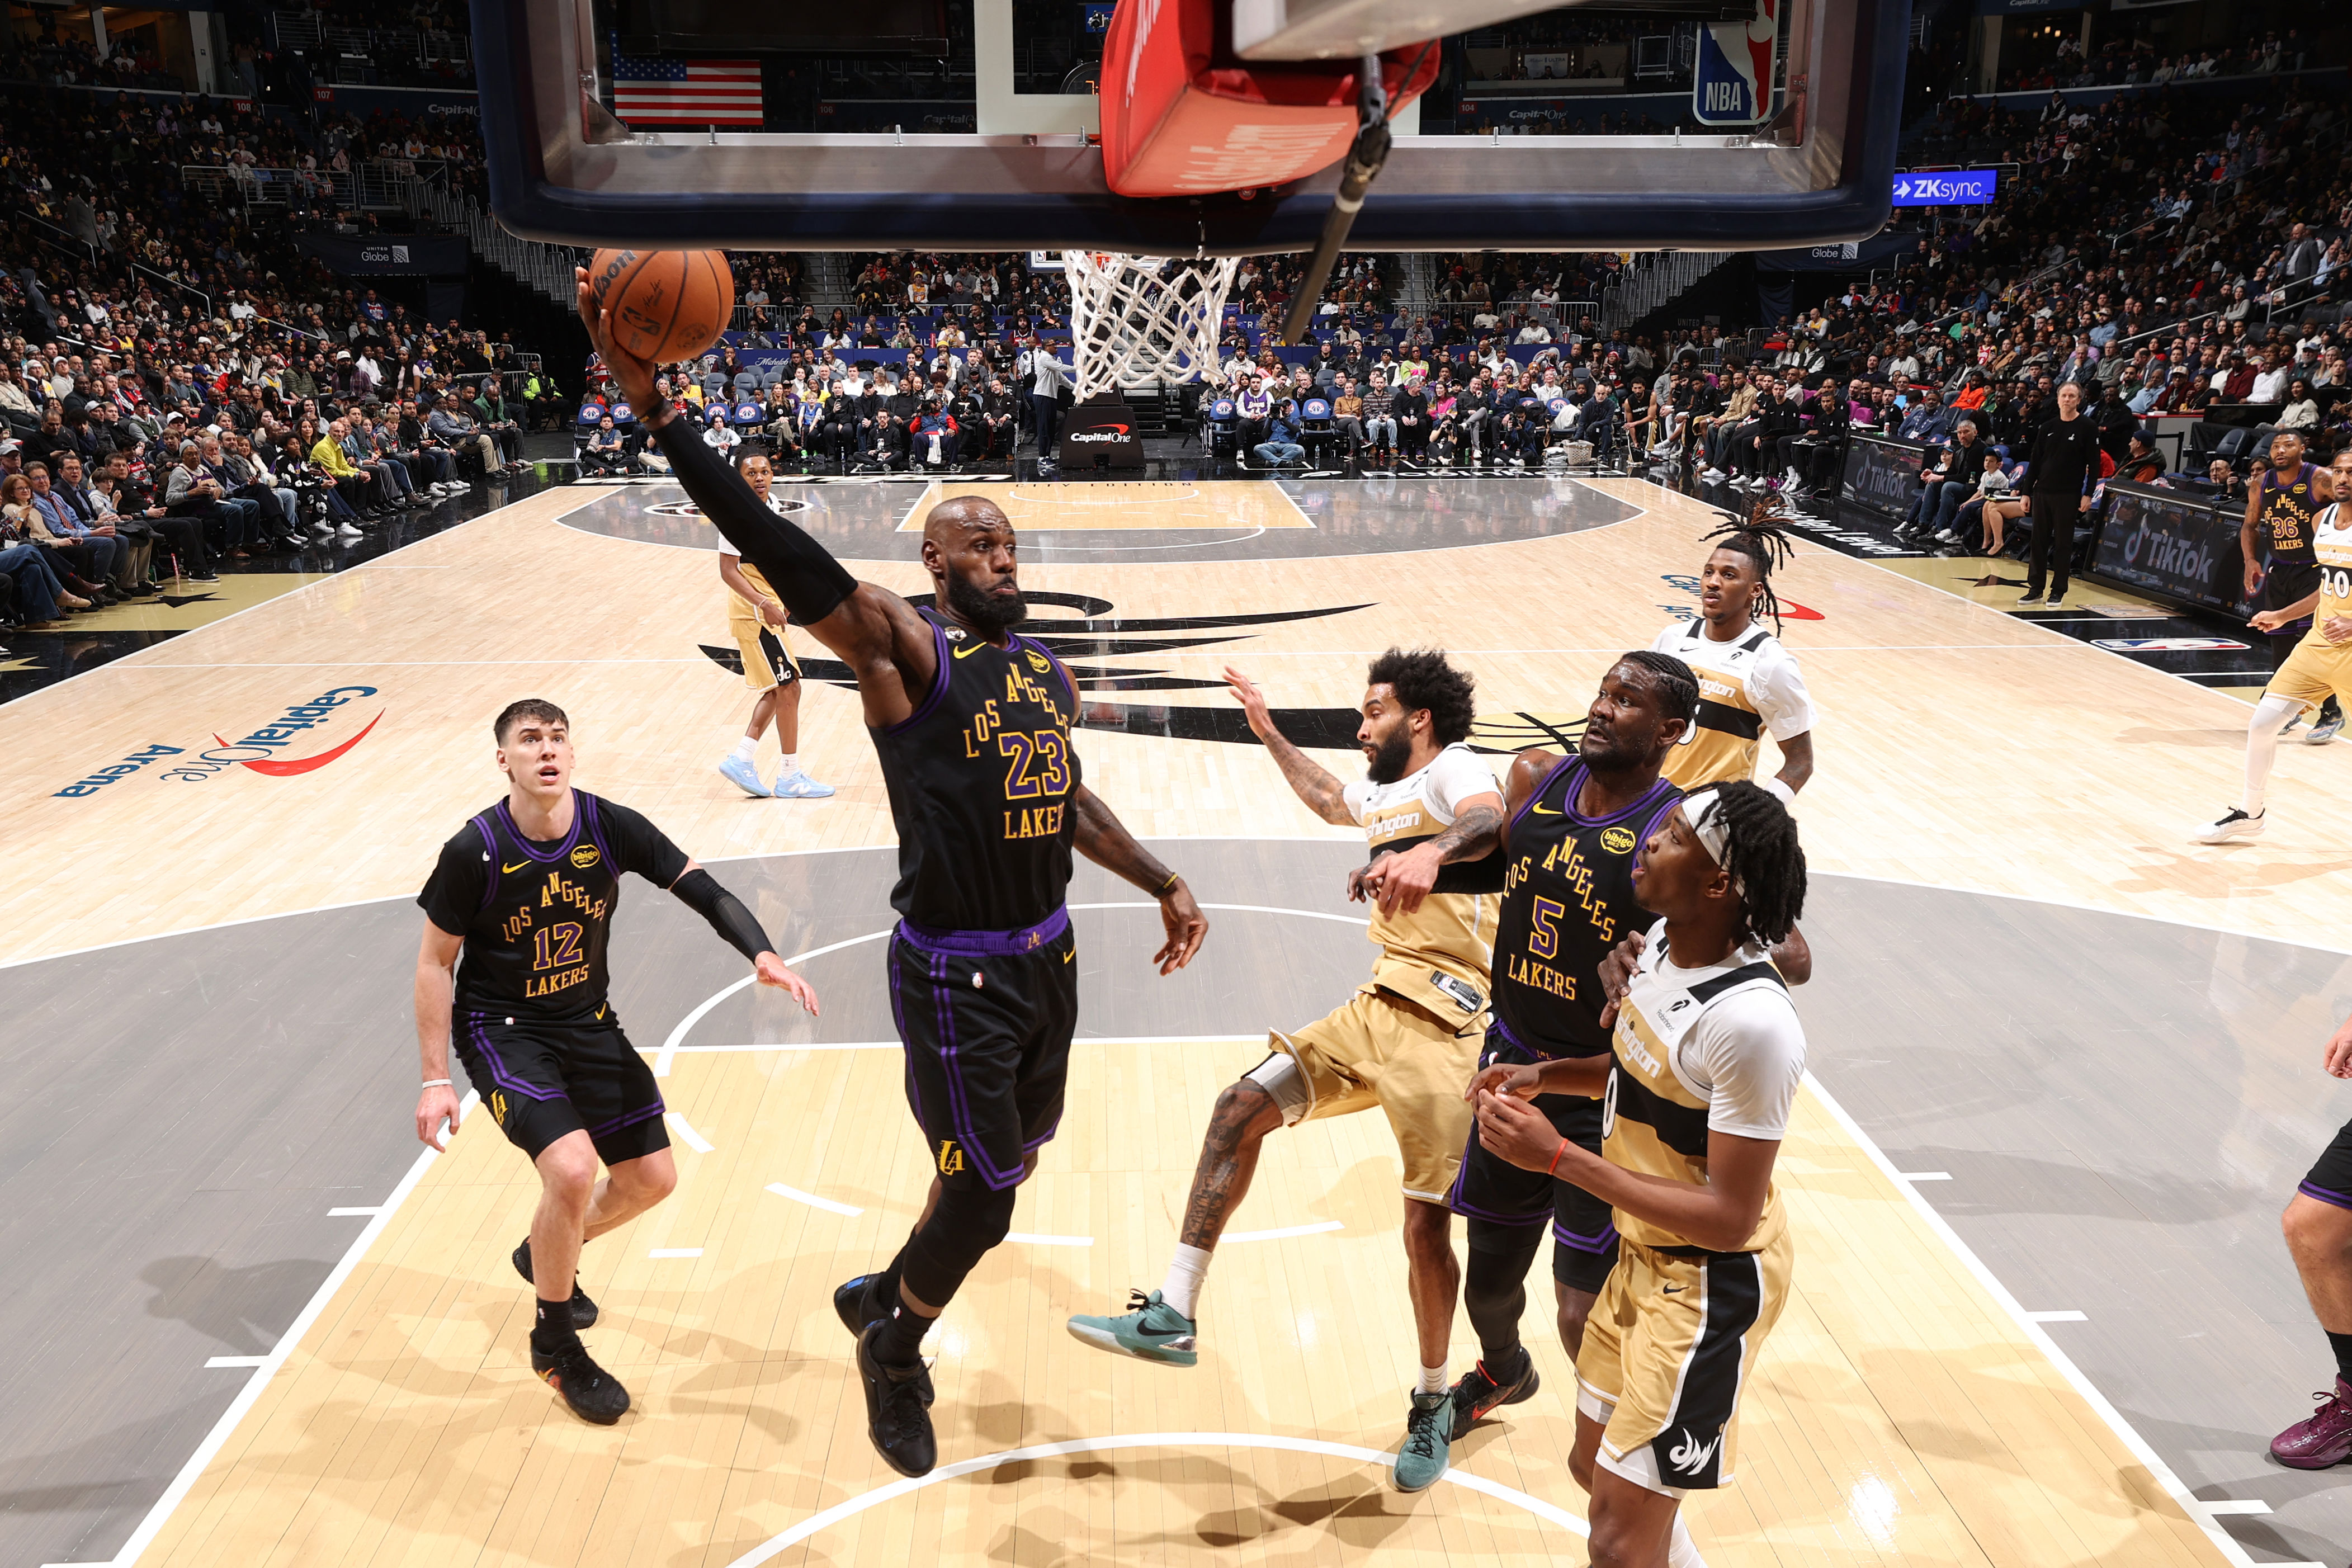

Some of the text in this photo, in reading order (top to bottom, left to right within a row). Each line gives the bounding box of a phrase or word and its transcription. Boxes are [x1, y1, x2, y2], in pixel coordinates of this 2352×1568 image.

[236, 102, 252, 112] 108
[316, 90, 331, 99] 107
[1461, 103, 1475, 112] 104
[1705, 82, 1742, 112] NBA
[428, 103, 480, 117] CapitalO
[1913, 179, 1982, 201] ZKsync
[361, 251, 390, 262] Globe
[1812, 248, 1838, 258] Globe
[1677, 318, 1701, 327] UNITED
[1869, 465, 1907, 499] TikTok
[2275, 494, 2310, 523] ANGELES
[2271, 517, 2299, 538] 36
[1821, 532, 1926, 555] Level
[2147, 532, 2214, 583] TikTok
[2274, 539, 2304, 550] LAKERS
[2321, 567, 2350, 599] 20
[962, 662, 1071, 759] LOS ANGELE
[50, 744, 186, 798] Arena
[997, 728, 1073, 801] 23
[1604, 833, 1633, 848] bibigo
[573, 850, 598, 861] bibigo
[1503, 834, 1616, 942] LOS ANGELES
[502, 905, 533, 943] LOS
[1528, 894, 1566, 960] 5
[533, 920, 584, 972] 12
[525, 963, 591, 998] LAKERS
[1508, 953, 1577, 1001] LAKERS
[1656, 1008, 1675, 1033] Robinhood
[939, 1140, 966, 1176] LA
